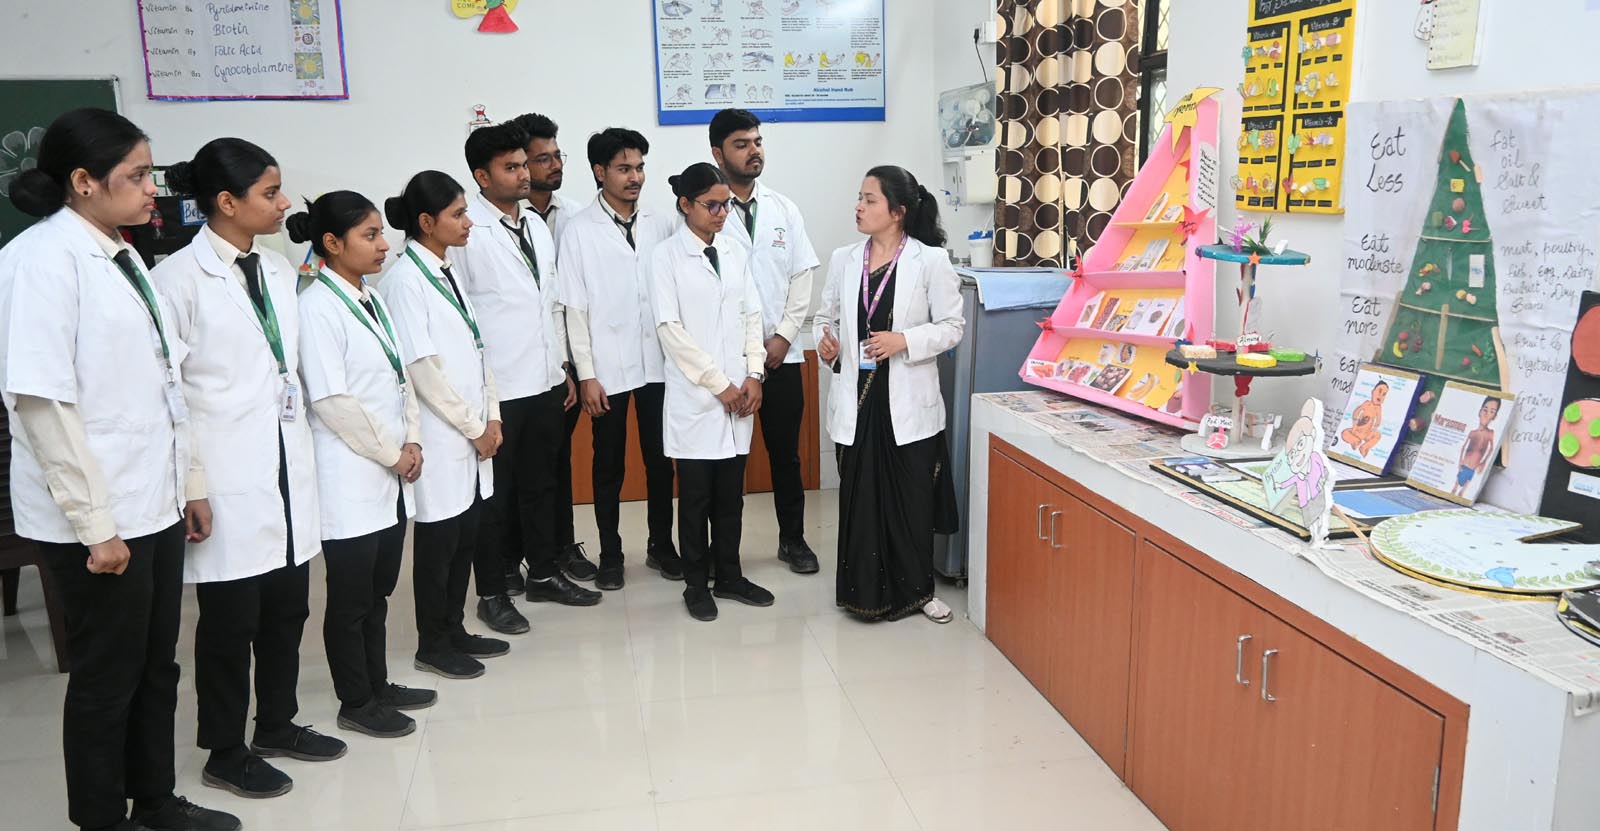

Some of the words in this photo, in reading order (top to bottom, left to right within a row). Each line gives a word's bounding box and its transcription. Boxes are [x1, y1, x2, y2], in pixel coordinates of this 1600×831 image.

[147, 26, 178, 36] Vitamin
[213, 23, 249, 36] Biotin
[150, 47, 180, 56] Vitamin
[239, 45, 263, 56] Acid
[152, 69, 182, 78] Vitamin
[1370, 126, 1407, 161] Eat
[1366, 163, 1404, 193] Less
[1361, 232, 1390, 254] Eat
[1352, 295, 1384, 317] Eat
[1344, 318, 1379, 337] more
[1331, 377, 1353, 394] mos
